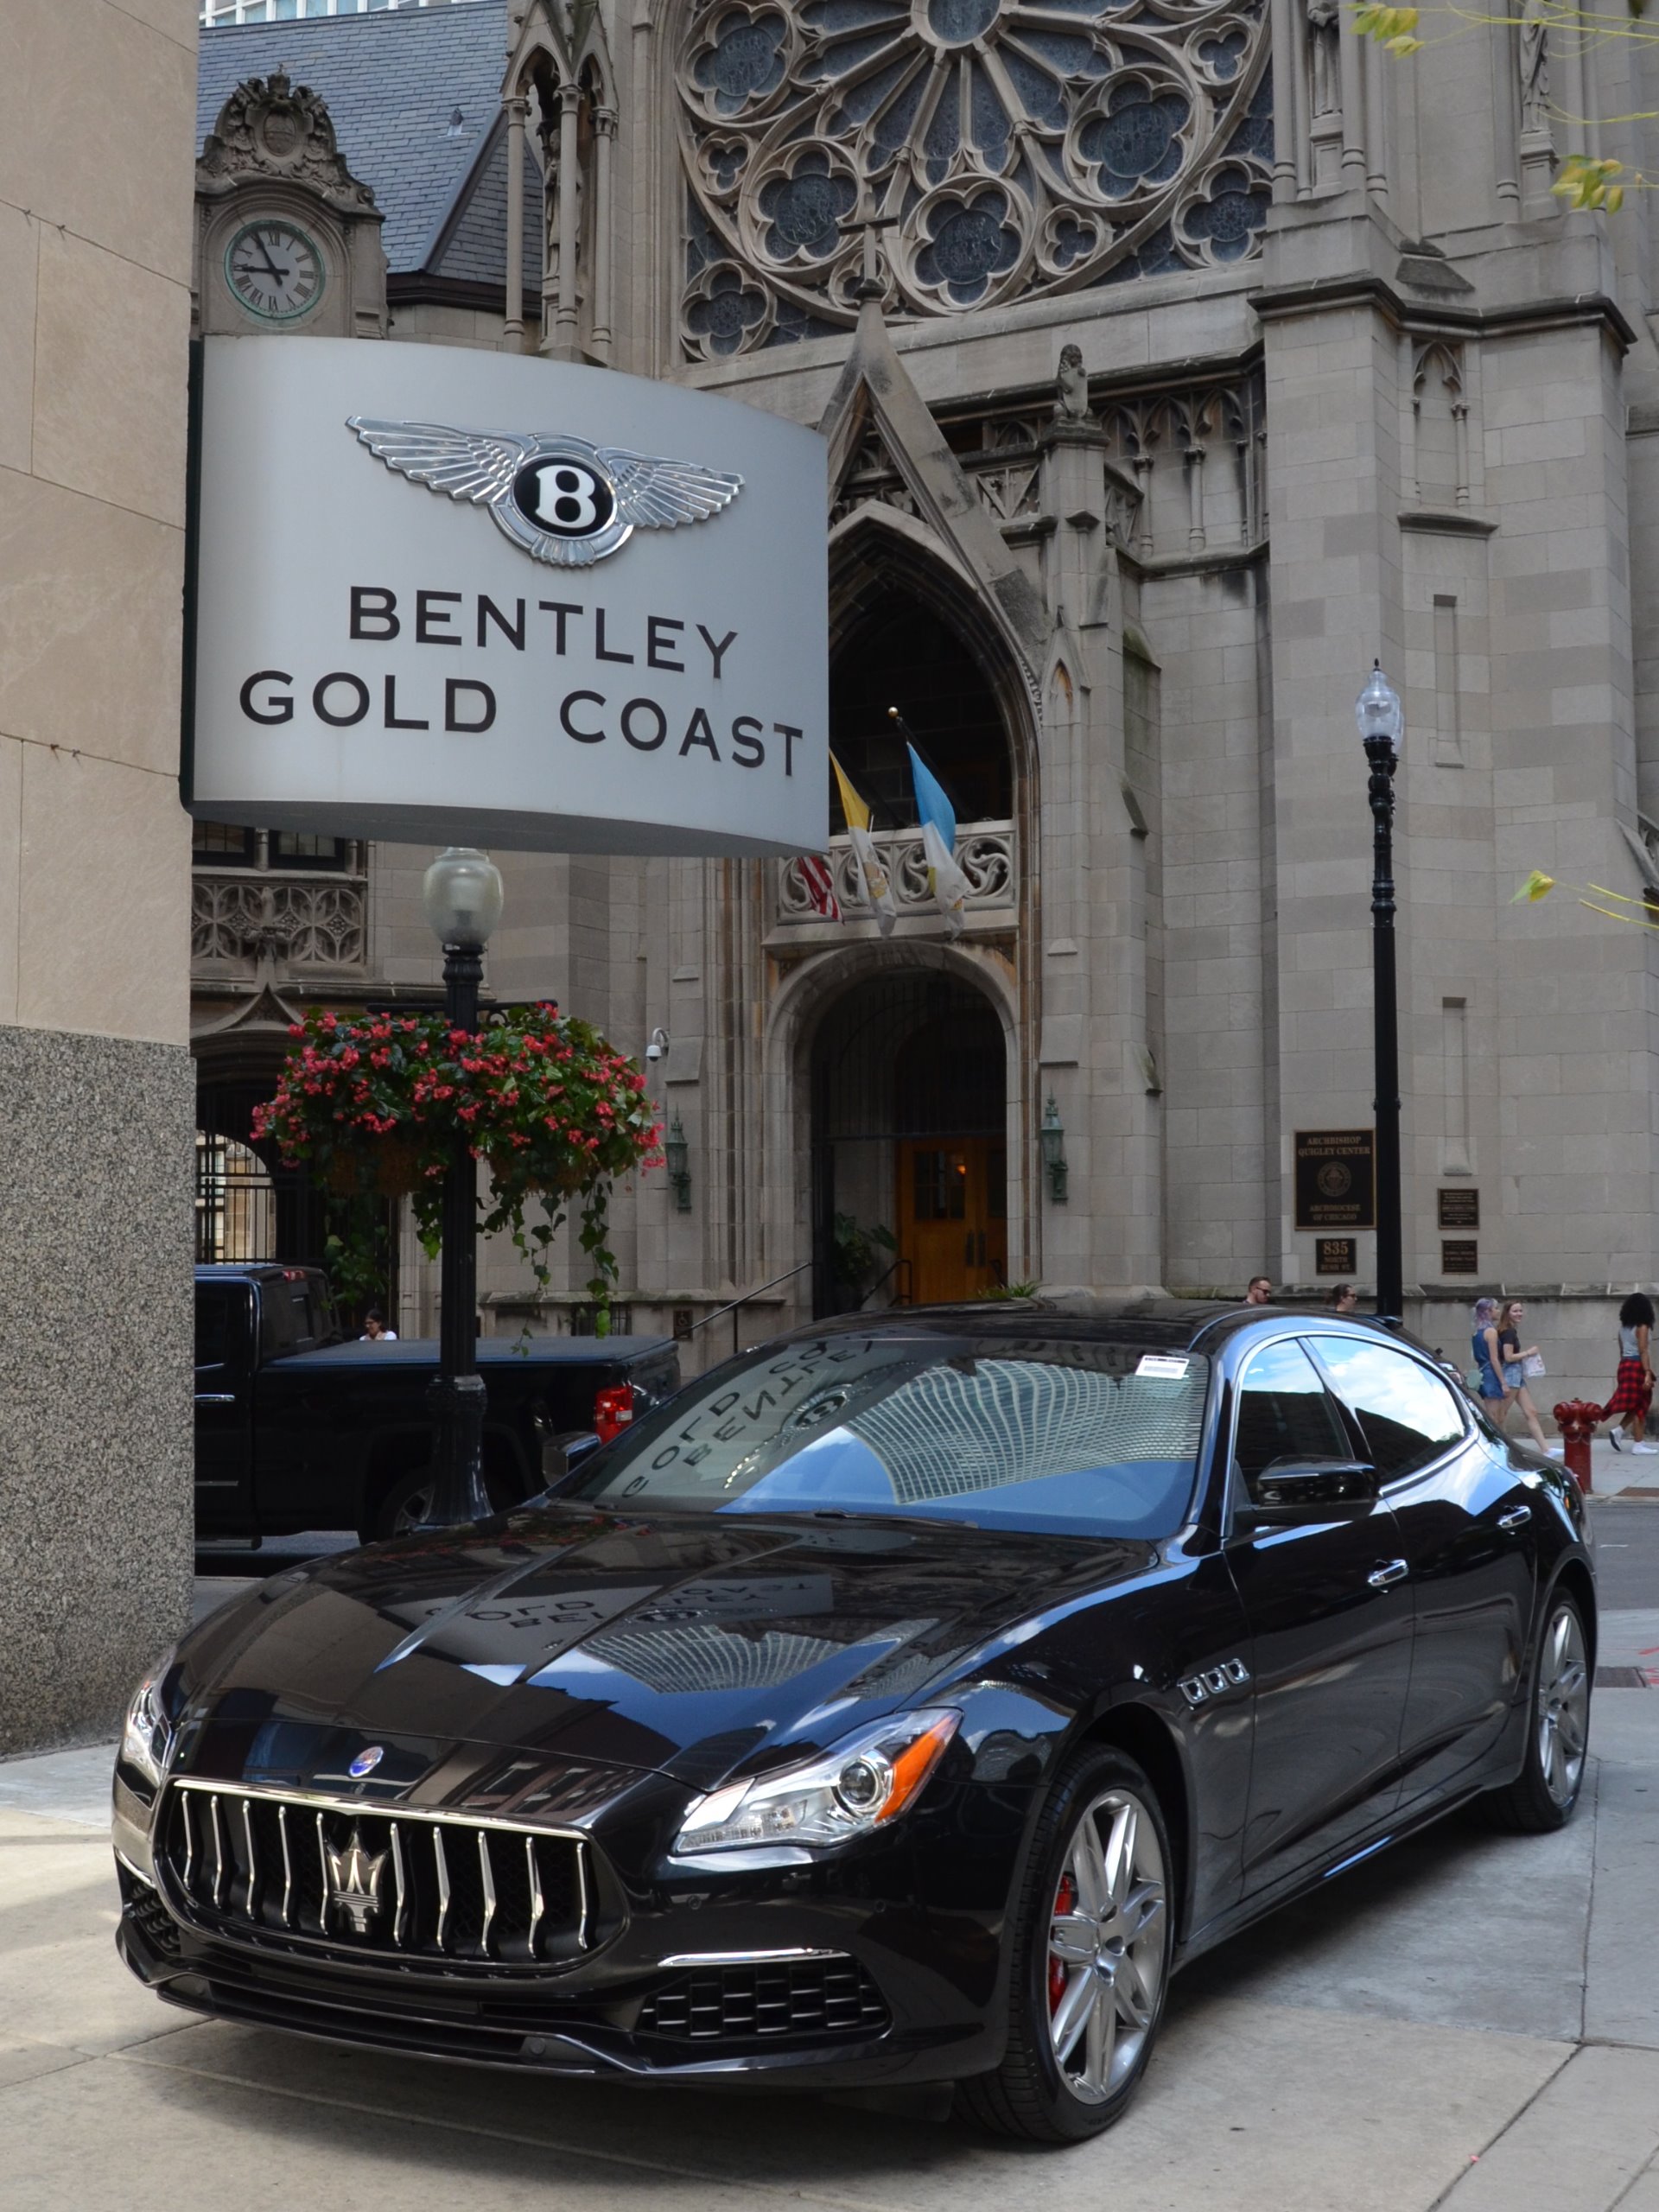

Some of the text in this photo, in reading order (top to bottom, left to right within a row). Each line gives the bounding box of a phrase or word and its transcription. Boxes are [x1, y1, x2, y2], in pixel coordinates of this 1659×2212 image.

[536, 464, 597, 530] B
[349, 585, 739, 679] BENTLEY
[238, 669, 804, 777] GOLD COAST
[1298, 1147, 1370, 1157] QUIGLEY CENTER
[1306, 1135, 1362, 1146] ARCHBISHOP
[1323, 1241, 1349, 1255] 835
